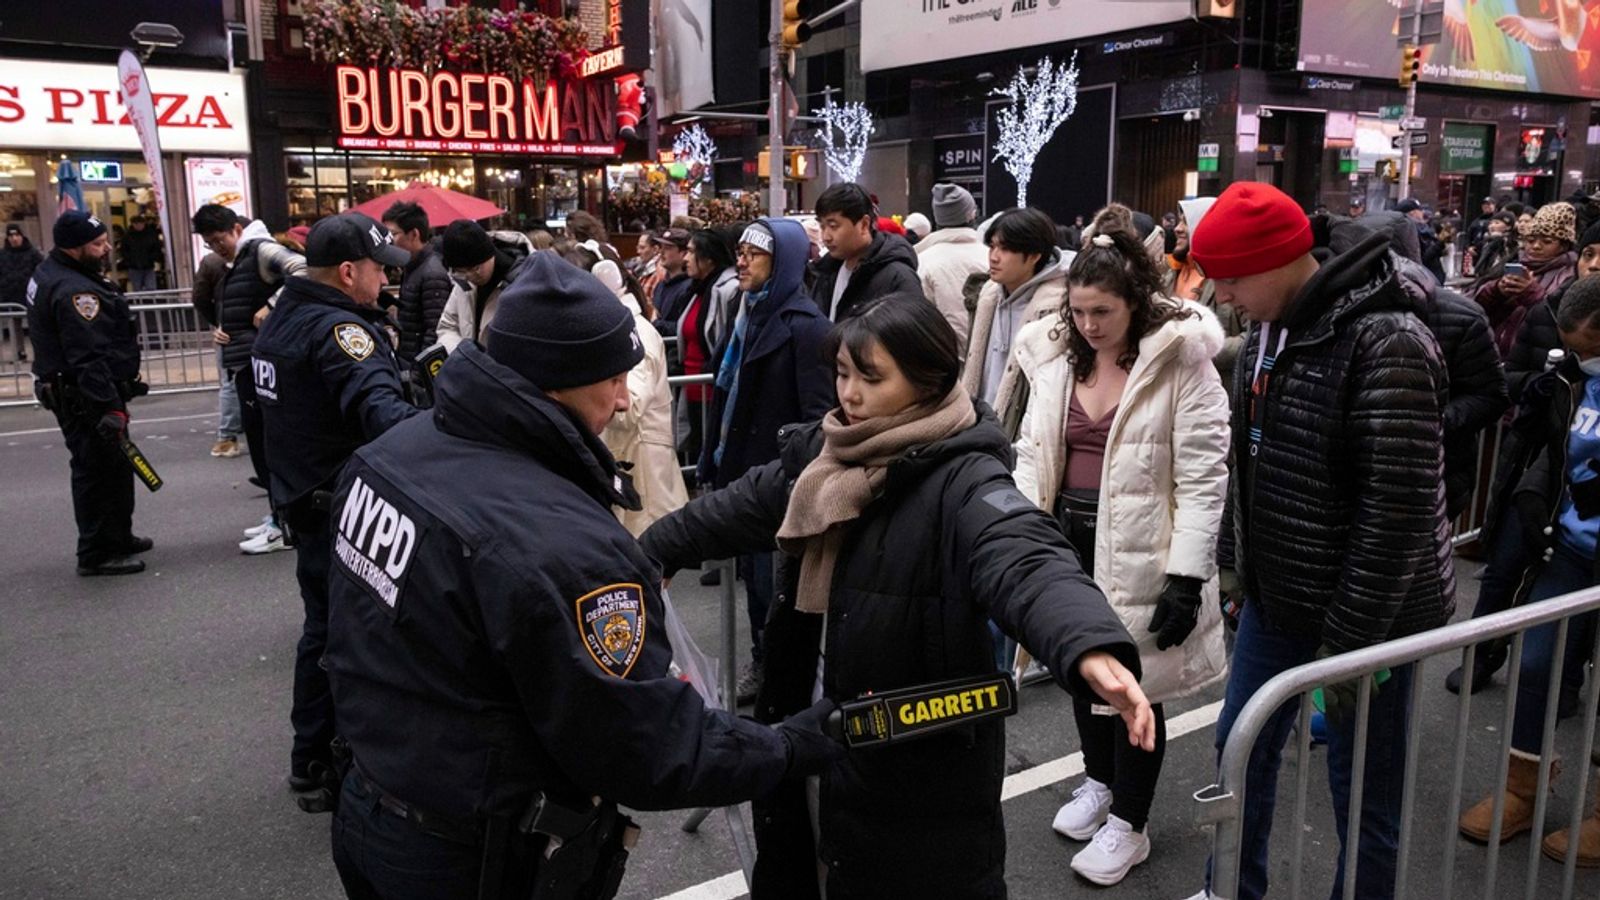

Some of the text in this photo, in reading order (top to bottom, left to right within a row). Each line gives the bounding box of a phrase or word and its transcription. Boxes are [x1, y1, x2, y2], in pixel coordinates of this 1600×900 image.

[1114, 35, 1164, 52] Clear Channel
[1422, 62, 1440, 78] Only
[1448, 65, 1479, 80] Theaters
[1479, 68, 1493, 81] This
[1493, 70, 1527, 85] Christmas
[336, 65, 613, 141] BURGER MAN
[342, 138, 378, 147] BREAKFAST
[448, 141, 473, 150] CHICKEN
[1443, 136, 1483, 148] STARBUCKS
[945, 148, 982, 165] SPIN
[250, 355, 276, 389] YPD
[1570, 405, 1600, 437] ST
[338, 475, 416, 580] NYPD
[596, 590, 629, 607] POLICE
[585, 600, 640, 624] DEPARTMENT
[587, 633, 603, 655] CITY
[898, 684, 1000, 725] GARRETT
